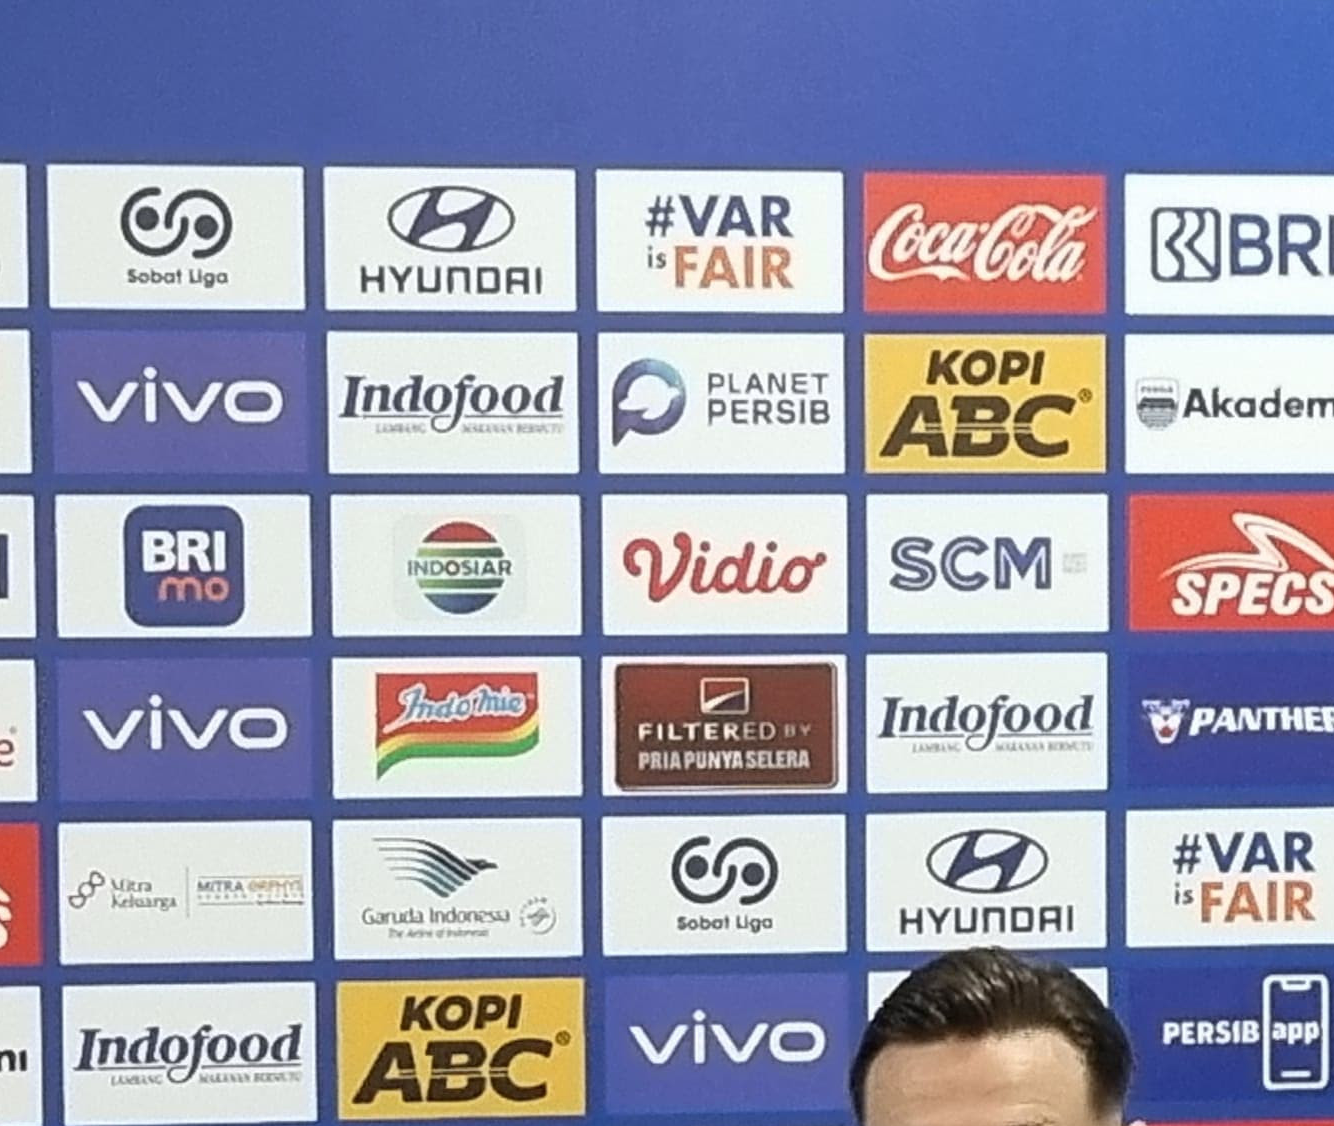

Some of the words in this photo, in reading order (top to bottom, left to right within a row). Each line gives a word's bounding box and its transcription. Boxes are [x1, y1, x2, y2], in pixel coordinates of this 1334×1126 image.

[645, 195, 793, 237] #VAR
[868, 202, 1096, 282] Coca-Cola
[360, 266, 541, 295] HYUNDAI
[647, 250, 667, 269] is
[674, 247, 793, 290] FAIR
[708, 372, 828, 394] PLANET
[927, 350, 1043, 385] KOPI
[77, 367, 284, 424] vivo
[338, 374, 564, 433] Indofood
[708, 400, 830, 425] PERSIB
[879, 395, 1077, 457] ABC
[143, 529, 225, 572] BRI
[407, 558, 512, 577] INDOSIAR
[623, 532, 826, 603] Vidio
[890, 537, 1050, 591] SCM
[159, 577, 229, 602] mo
[82, 694, 288, 750] vivo
[384, 682, 526, 732] Indomie
[877, 694, 1093, 751] Indofood
[639, 721, 776, 742] FILTERED
[785, 725, 810, 737] BY
[639, 750, 682, 771] PRIA
[684, 750, 744, 771] PUNYA
[746, 750, 810, 769] SELERA
[1173, 832, 1314, 873] #VAR
[362, 906, 424, 925] Garuda
[429, 906, 510, 924] Indonesia
[900, 906, 1072, 935] HYUNDAI
[1175, 884, 1194, 903] is
[1200, 882, 1314, 923] FAIR
[677, 915, 728, 930] Sobat
[734, 915, 773, 933] Liga
[400, 995, 522, 1031] KOPI
[1162, 1021, 1259, 1045] PERSIB
[1272, 1019, 1320, 1046] app
[75, 1023, 301, 1084] Indofood
[630, 1010, 826, 1064] vivo
[352, 1040, 552, 1104] ABC
